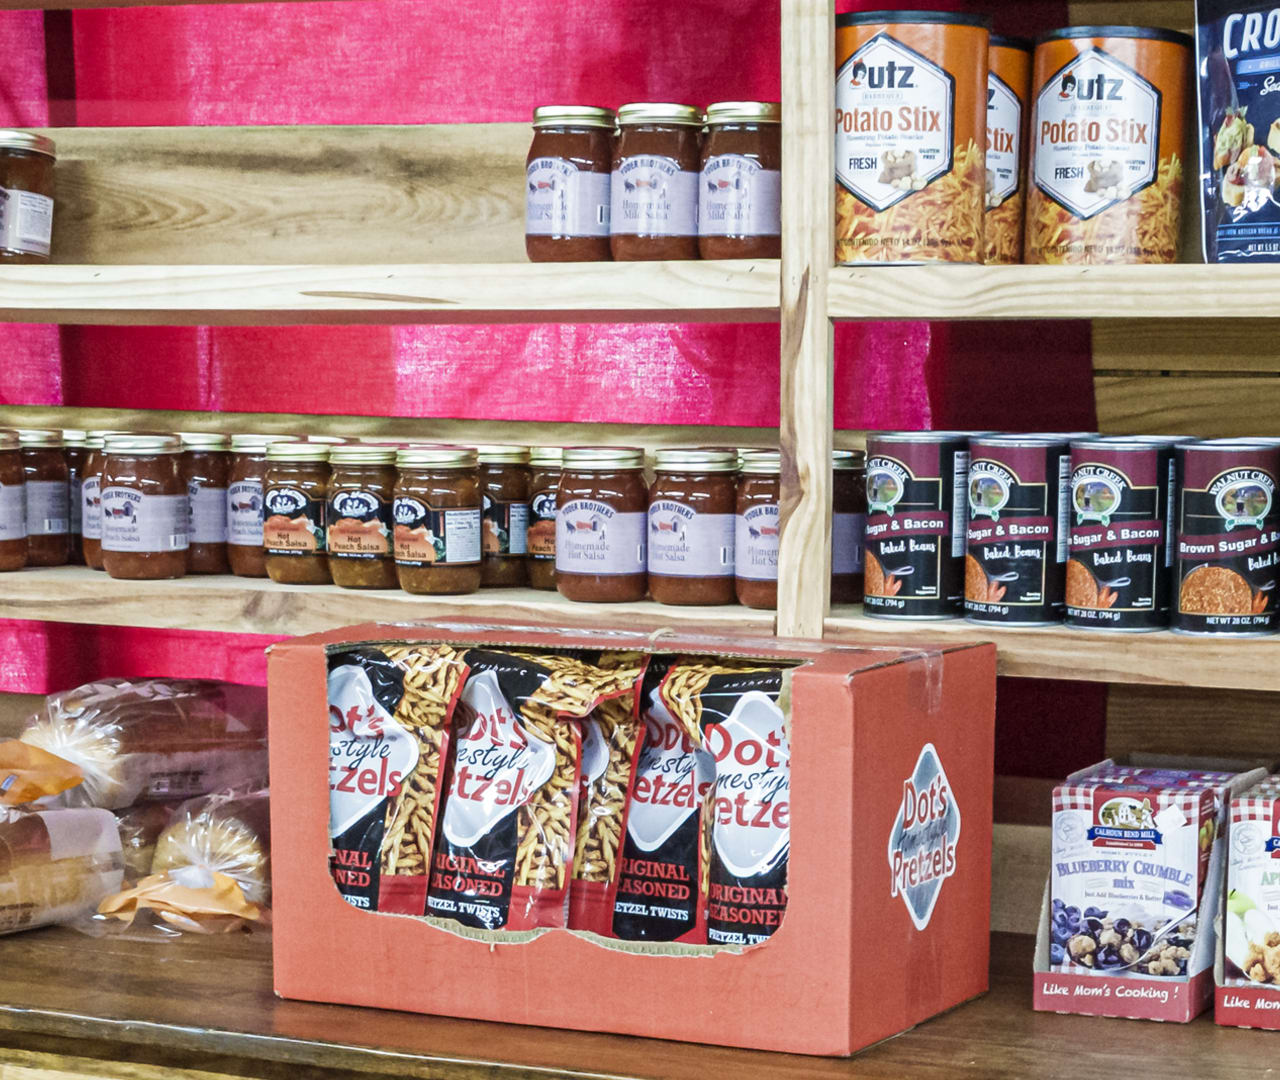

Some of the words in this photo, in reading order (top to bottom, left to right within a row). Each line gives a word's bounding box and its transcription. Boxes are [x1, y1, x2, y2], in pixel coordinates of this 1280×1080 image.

[835, 107, 893, 133] Potato
[898, 107, 942, 132] Stix
[1041, 119, 1100, 145] Potato
[1106, 119, 1148, 145] Stix
[848, 157, 878, 171] FRESH
[1054, 166, 1084, 180] FRESH
[881, 459, 910, 482] CREEK
[987, 464, 1015, 488] CREEK
[1096, 467, 1126, 491] CREEK
[1210, 471, 1249, 496] WALNUT
[580, 502, 615, 519] BROTHERS
[664, 502, 696, 520] BROTHERS
[904, 518, 944, 530] Bacon
[277, 531, 290, 541] Hot
[969, 528, 992, 540] Sugar
[1010, 524, 1049, 535] Bacon
[1073, 533, 1102, 546] Sugar
[1121, 528, 1159, 540] Bacon
[285, 540, 308, 548] Salsa
[334, 542, 356, 551] Peach
[357, 542, 380, 551] Salsa
[347, 535, 362, 544] Hot
[880, 541, 906, 554] Baked
[909, 539, 936, 553] Beans
[1180, 542, 1215, 554] Brown
[1220, 537, 1257, 551] Sugar
[400, 543, 411, 551] Hot
[984, 548, 1011, 560] Baked
[1014, 546, 1041, 558] Beans
[407, 550, 427, 559] Salsa
[584, 551, 606, 561] Salsa
[669, 552, 686, 562] Salsa
[1094, 553, 1122, 566] Baked
[1127, 551, 1152, 564] Beans
[1248, 557, 1272, 571] Baked
[903, 774, 948, 830] Dot's
[1094, 828, 1123, 838] CALHOUN
[1124, 829, 1140, 838] BEND
[1140, 830, 1156, 839] MILL
[890, 835, 956, 899] Pretzels
[1056, 859, 1130, 878] BLUEBERRY
[1133, 860, 1193, 887] CRUMBLE
[1112, 876, 1135, 890] mix
[1084, 891, 1095, 899] Just
[1096, 892, 1107, 900] Add
[650, 906, 689, 921] TWISTS
[1267, 903, 1279, 911] Just
[1043, 983, 1069, 996] Like
[1073, 983, 1111, 998] Mom's
[1115, 986, 1169, 1003] Cooking
[1223, 995, 1250, 1009] Like
